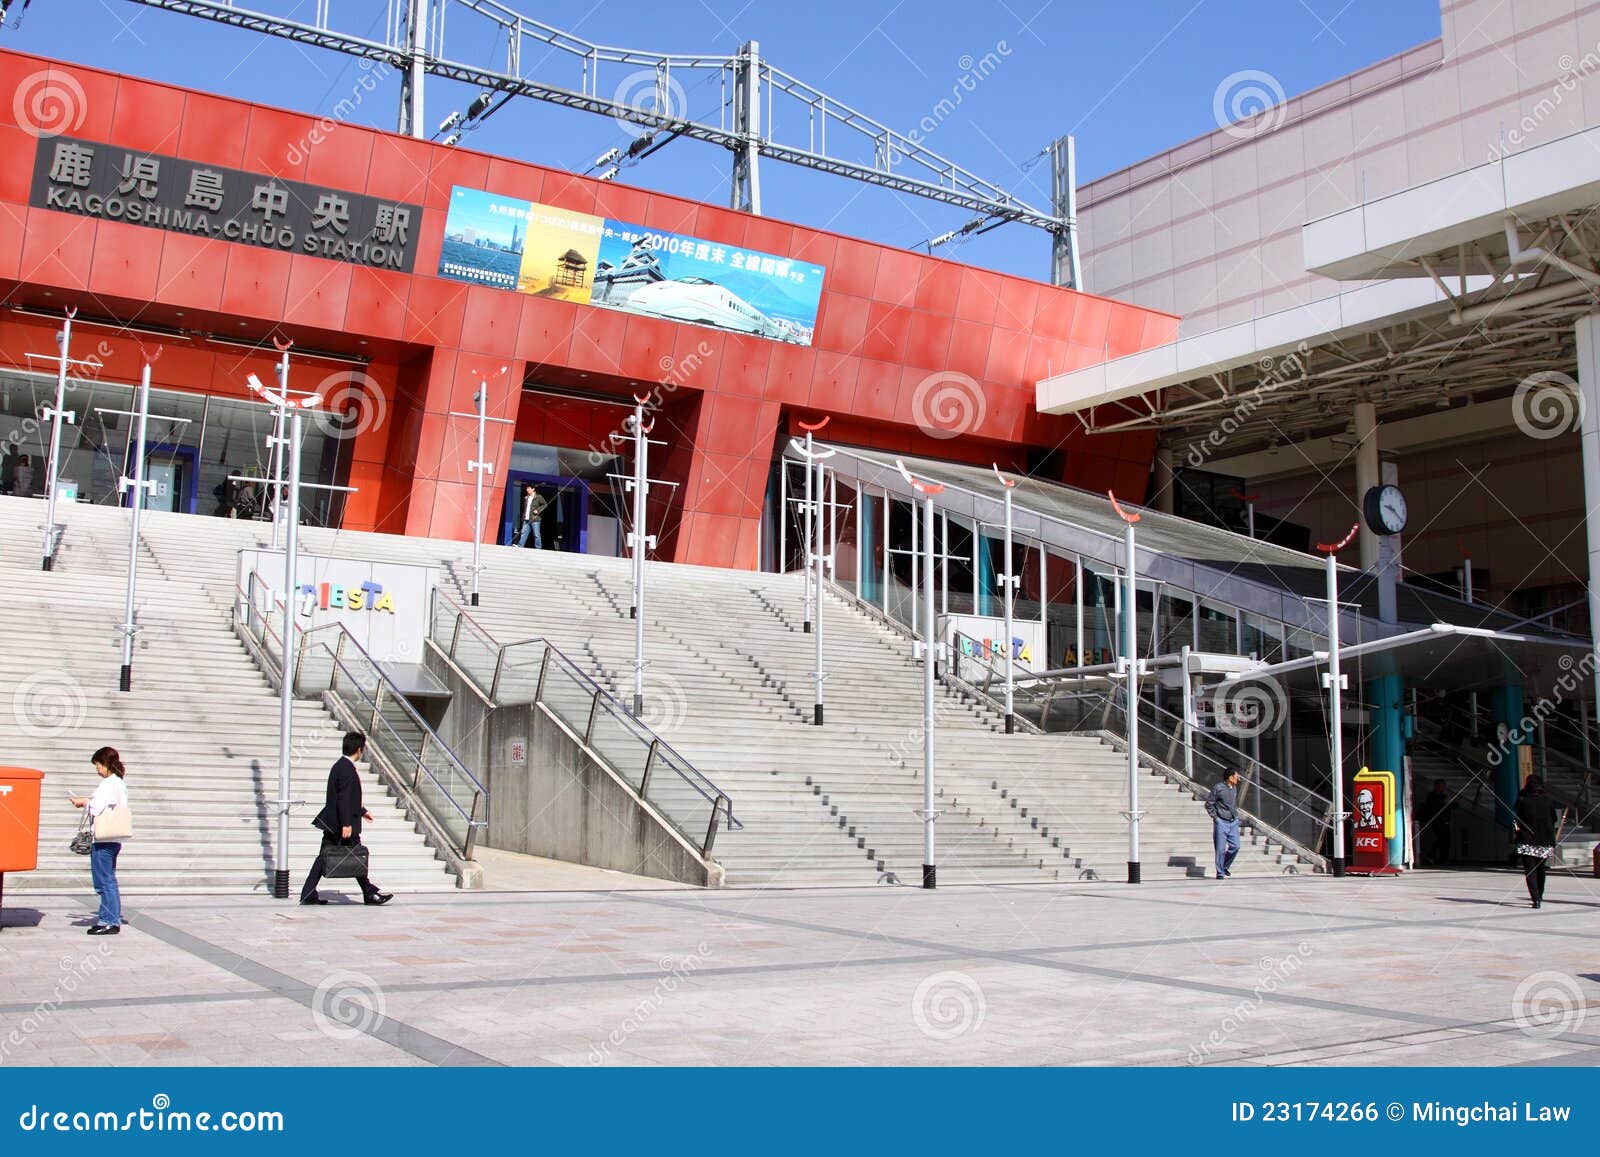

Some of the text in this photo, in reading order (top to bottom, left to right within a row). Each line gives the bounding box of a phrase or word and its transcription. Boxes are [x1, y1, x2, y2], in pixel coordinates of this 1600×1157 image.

[49, 143, 410, 245] 鹿児島中央駅
[303, 234, 404, 268] STATION
[295, 580, 395, 615] RIESTA
[1355, 837, 1379, 848] KFC
